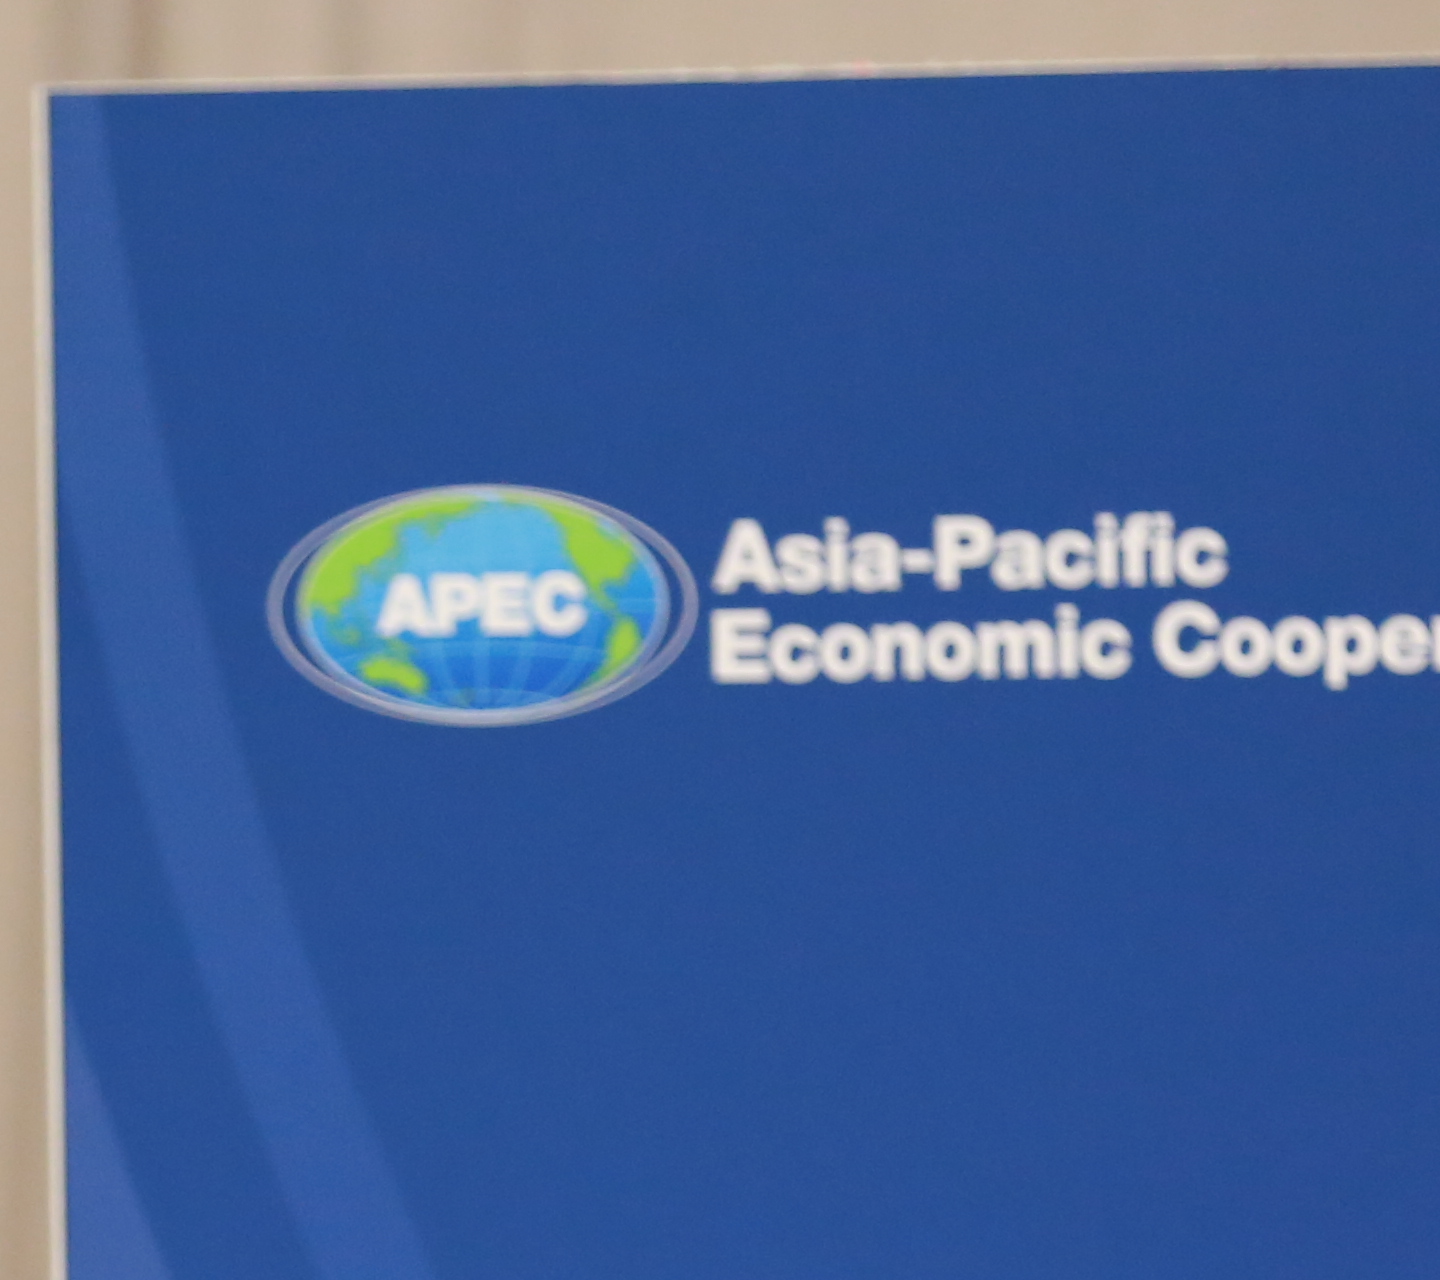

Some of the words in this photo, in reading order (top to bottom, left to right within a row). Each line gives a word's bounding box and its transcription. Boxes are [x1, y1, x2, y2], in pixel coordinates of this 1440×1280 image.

[711, 510, 1229, 593] Asia-Pacific
[376, 567, 591, 639] APEC
[709, 603, 1131, 685] Economic
